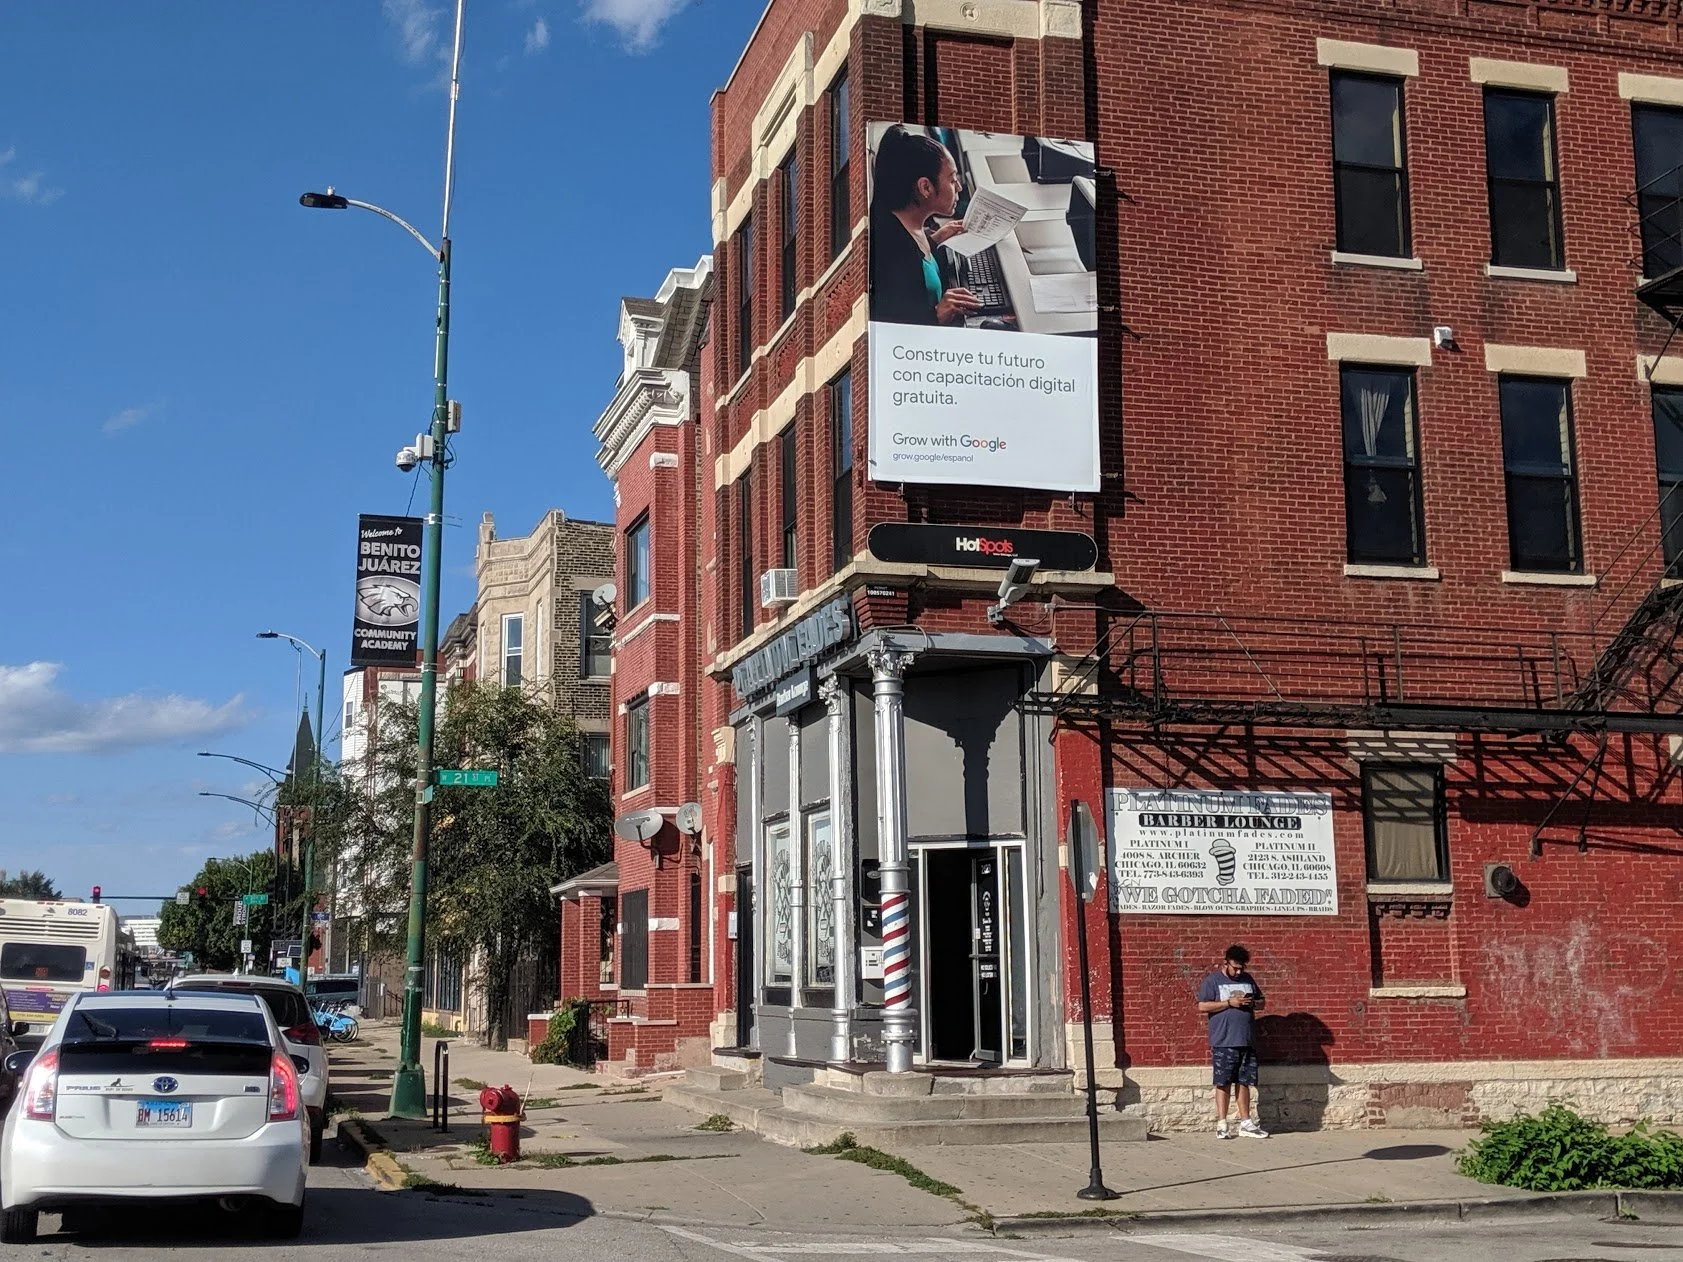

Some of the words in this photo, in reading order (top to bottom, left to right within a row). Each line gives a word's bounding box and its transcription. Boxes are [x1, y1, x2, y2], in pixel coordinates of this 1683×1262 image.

[892, 346, 973, 366] Construye
[978, 350, 993, 365] tu
[998, 352, 1045, 369] futuro
[892, 369, 922, 382] con
[926, 371, 1024, 388] capacitación
[1029, 376, 1075, 394] digital
[892, 390, 958, 406] gratuita.
[892, 432, 928, 446] Grow
[931, 434, 957, 447] with
[960, 434, 1006, 452] Google
[892, 452, 974, 462] grow.google/espanol
[361, 529, 394, 538] Welcome
[394, 527, 403, 536] to
[360, 542, 420, 558] BENITO
[956, 537, 1013, 555] HotSpots
[358, 556, 421, 575] JUÁREZ
[354, 629, 417, 640] COMMUNITY
[361, 640, 409, 650] ACADEMY
[1111, 792, 1244, 814] PLATINUM
[1246, 796, 1328, 816] FADES
[1143, 814, 1217, 828] BARBER
[1224, 816, 1298, 829] LOUNGE
[1139, 829, 1304, 839] www.platinumfades.com
[1162, 887, 1252, 904] GOTCHA
[157, 1109, 188, 1122] 15614
